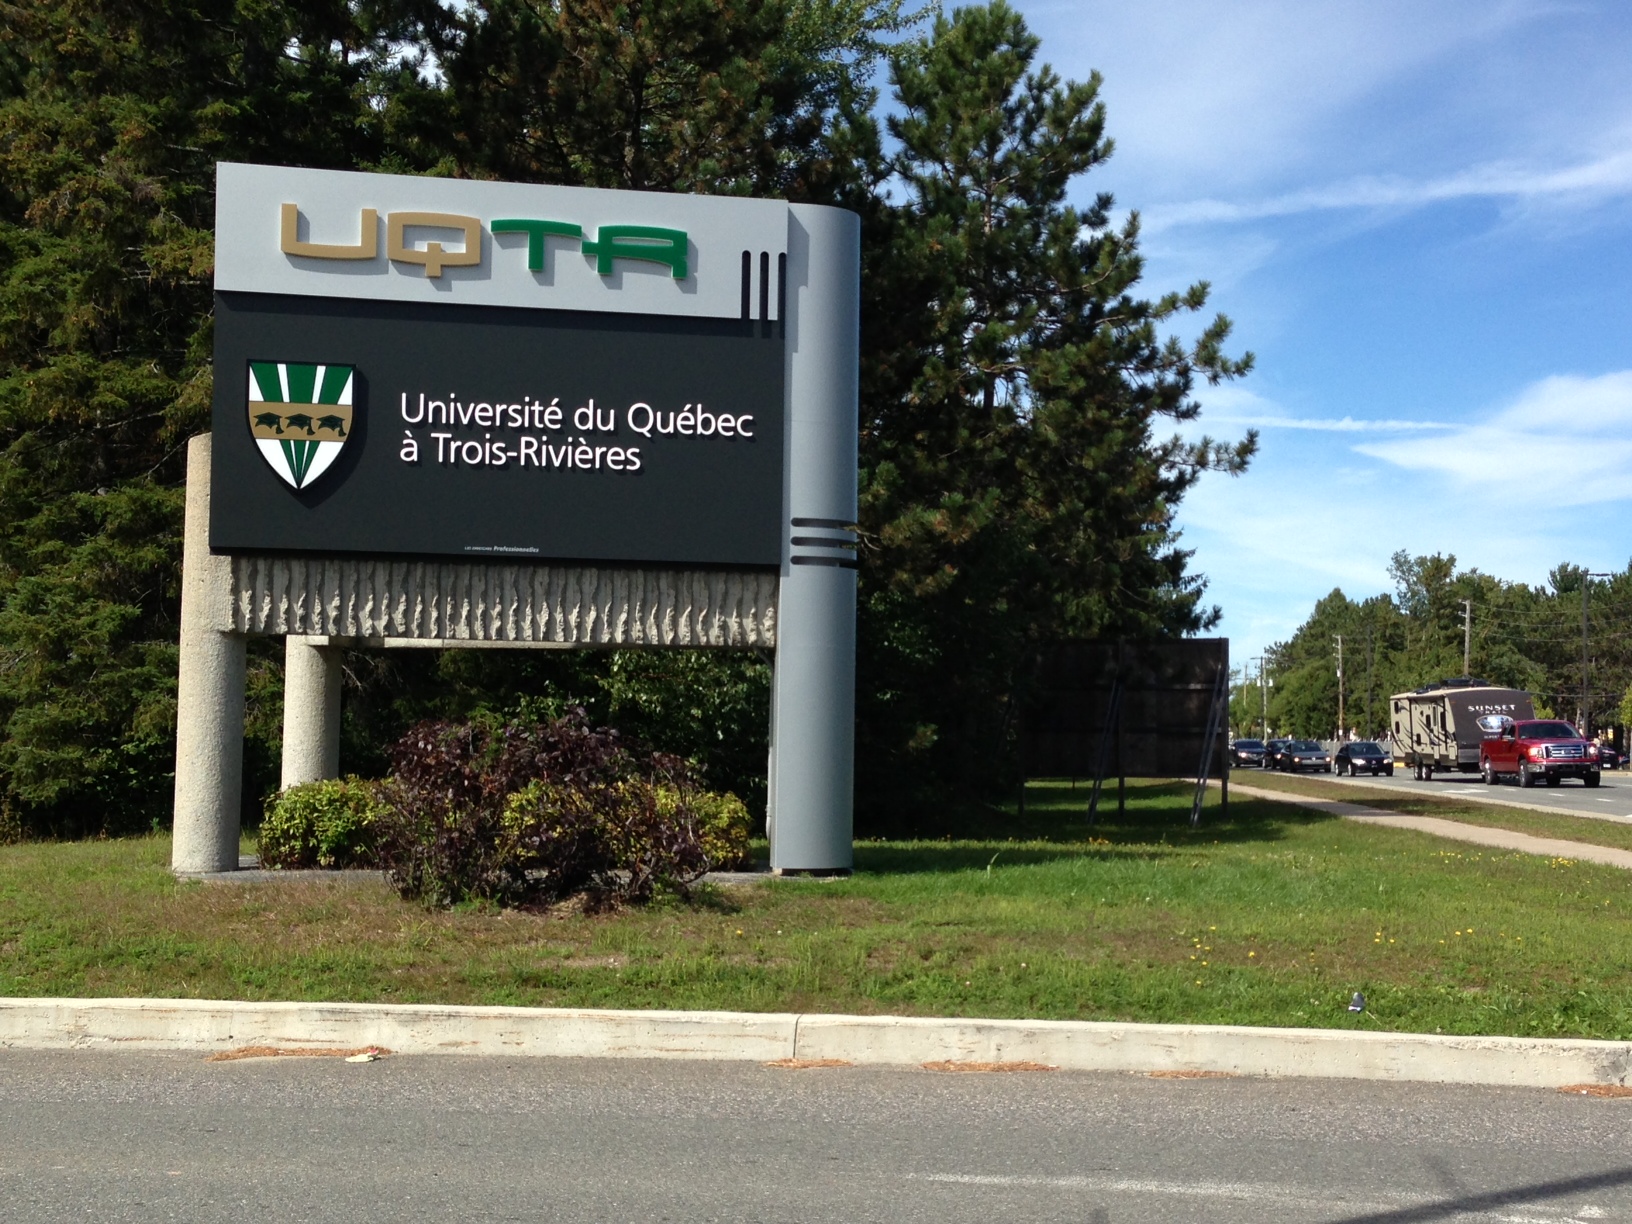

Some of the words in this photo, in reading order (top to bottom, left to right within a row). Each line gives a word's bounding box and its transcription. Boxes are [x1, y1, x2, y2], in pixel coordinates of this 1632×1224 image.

[281, 203, 688, 280] UQTR
[401, 392, 564, 430] Université
[574, 399, 615, 431] du
[627, 402, 754, 438] Québec
[400, 430, 418, 462] à
[430, 432, 641, 471] Trois-Rivières
[1467, 704, 1516, 712] SUNSET
